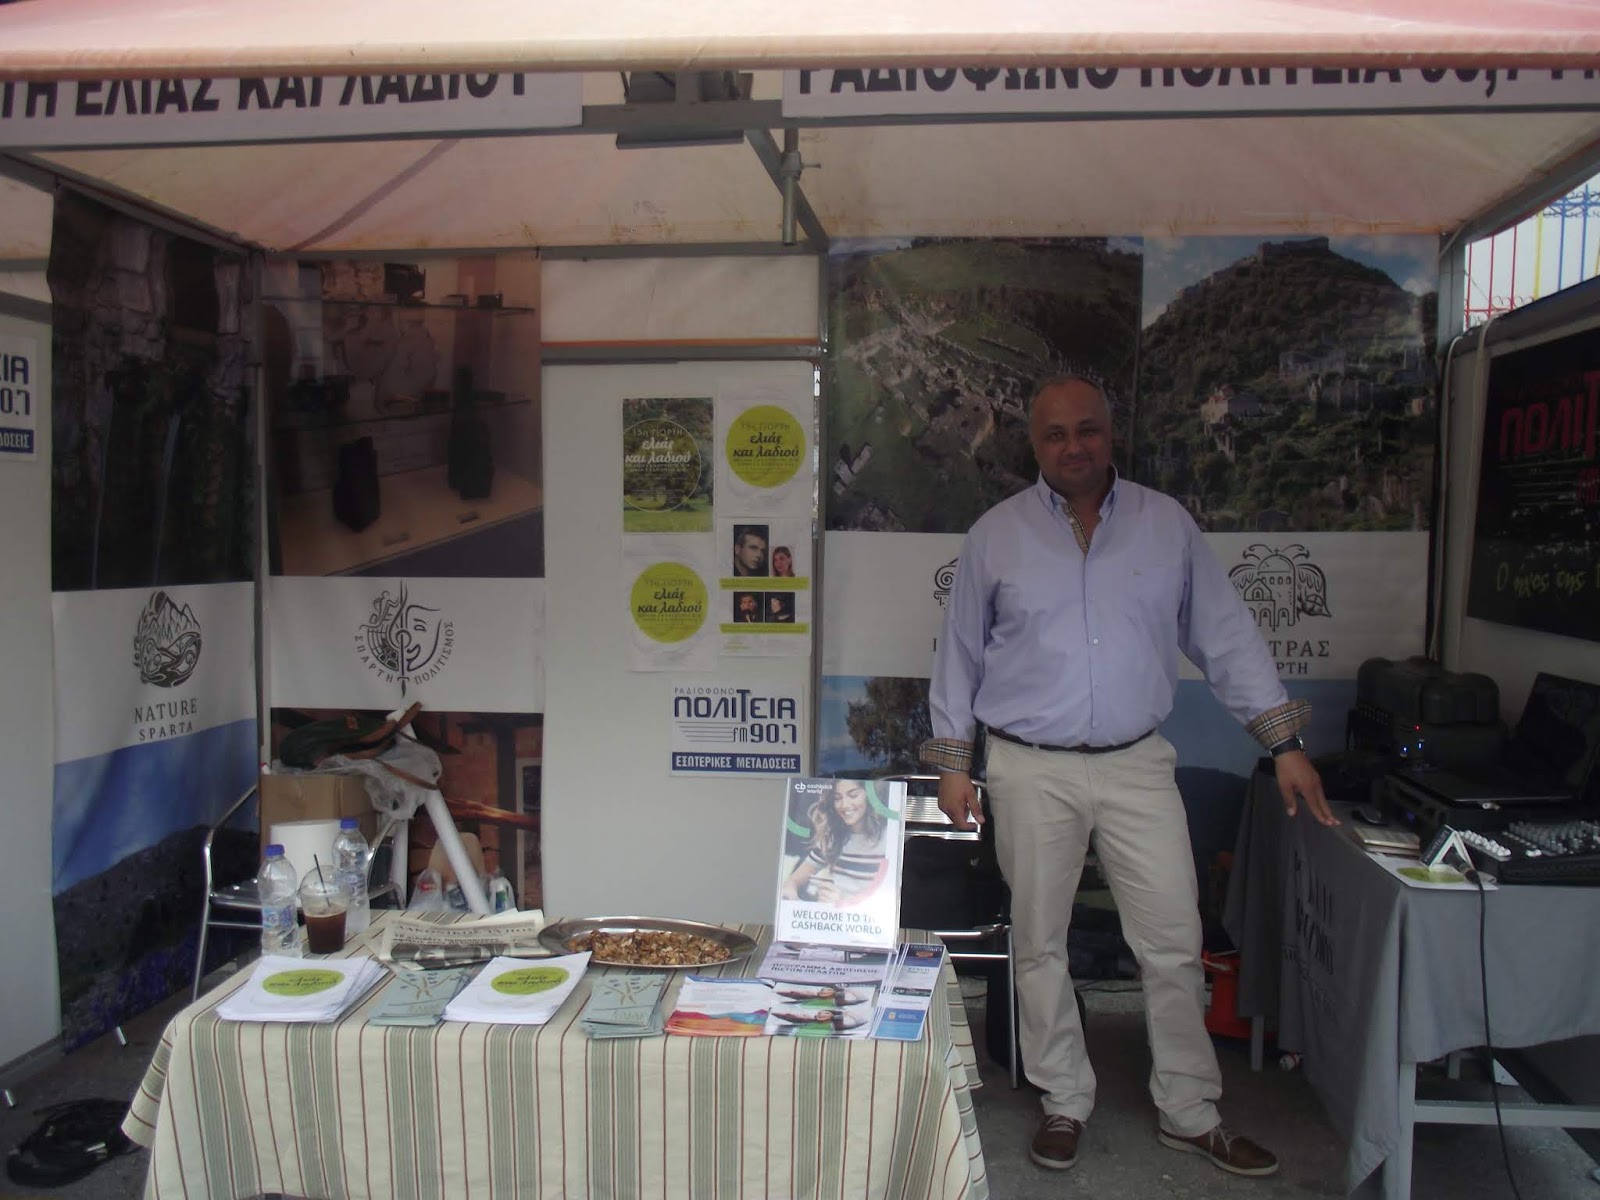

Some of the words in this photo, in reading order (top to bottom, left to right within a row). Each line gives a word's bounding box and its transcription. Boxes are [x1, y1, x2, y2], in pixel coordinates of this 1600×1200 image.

[749, 431, 783, 445] ελιάς
[625, 454, 647, 464] και
[648, 451, 692, 465] λαδιού
[733, 448, 754, 458] και
[756, 445, 800, 459] λαδιού
[653, 587, 686, 601] ελιάς
[637, 604, 658, 613] και
[659, 600, 702, 615] λαδιού
[355, 635, 394, 684] ΣΠΑΡΤΗ
[413, 621, 455, 686] ΠΟΛΙΤΙΣΜΟΣ
[674, 686, 735, 695] ΡΑΔΙΟΦΩΝΟ
[134, 698, 198, 725] NATURE
[674, 689, 796, 723] ΠΟΛΙΤΕΙΑ
[139, 720, 194, 742] SPARTA
[750, 723, 797, 744] 90.7
[676, 755, 732, 769] ΕΞΩΤΕΡΙΚΕΣ
[736, 756, 797, 770] ΜΕΤΑΔΟΣΕΙΣ
[792, 909, 844, 922] WELCOME
[846, 913, 861, 923] TO
[791, 920, 843, 932] CASHBACK
[845, 923, 882, 935] WORLD
